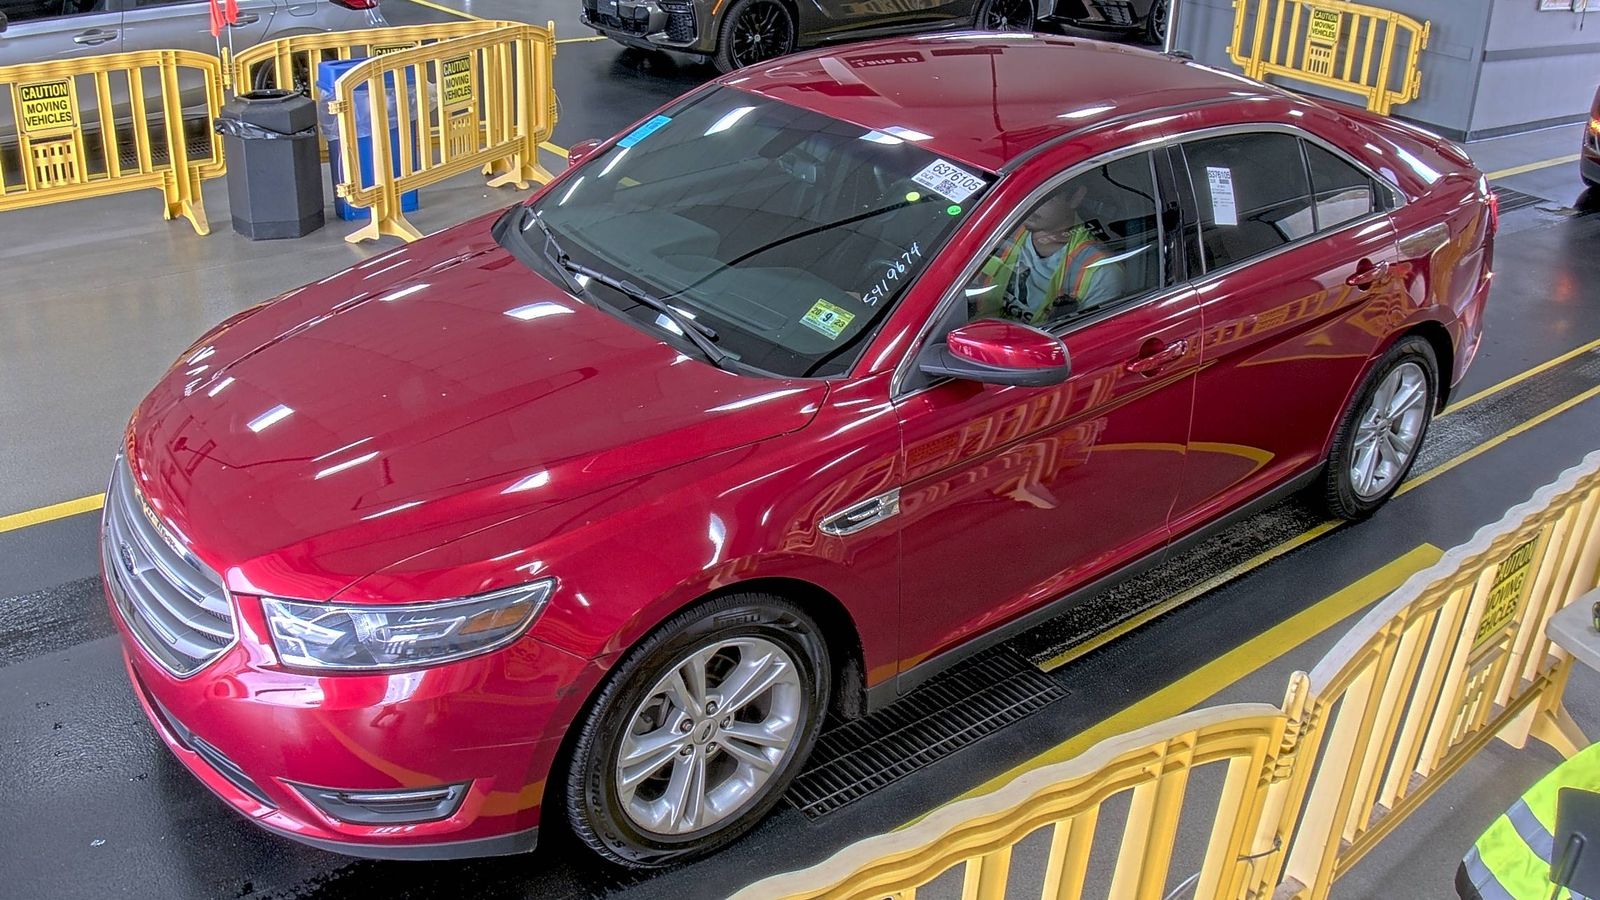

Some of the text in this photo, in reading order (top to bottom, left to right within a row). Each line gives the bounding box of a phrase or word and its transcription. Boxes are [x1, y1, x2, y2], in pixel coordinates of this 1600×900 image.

[444, 60, 470, 76] CAUTION
[446, 74, 469, 88] MOVING
[22, 83, 67, 100] CAUTION
[444, 85, 471, 101] VEHICLES
[27, 100, 67, 114] MOVING
[25, 111, 72, 126] VEHICLES
[933, 163, 981, 191] 6376105
[822, 312, 833, 323] 9
[1476, 594, 1520, 640] EHICLES
[591, 756, 626, 849] SCRPION
